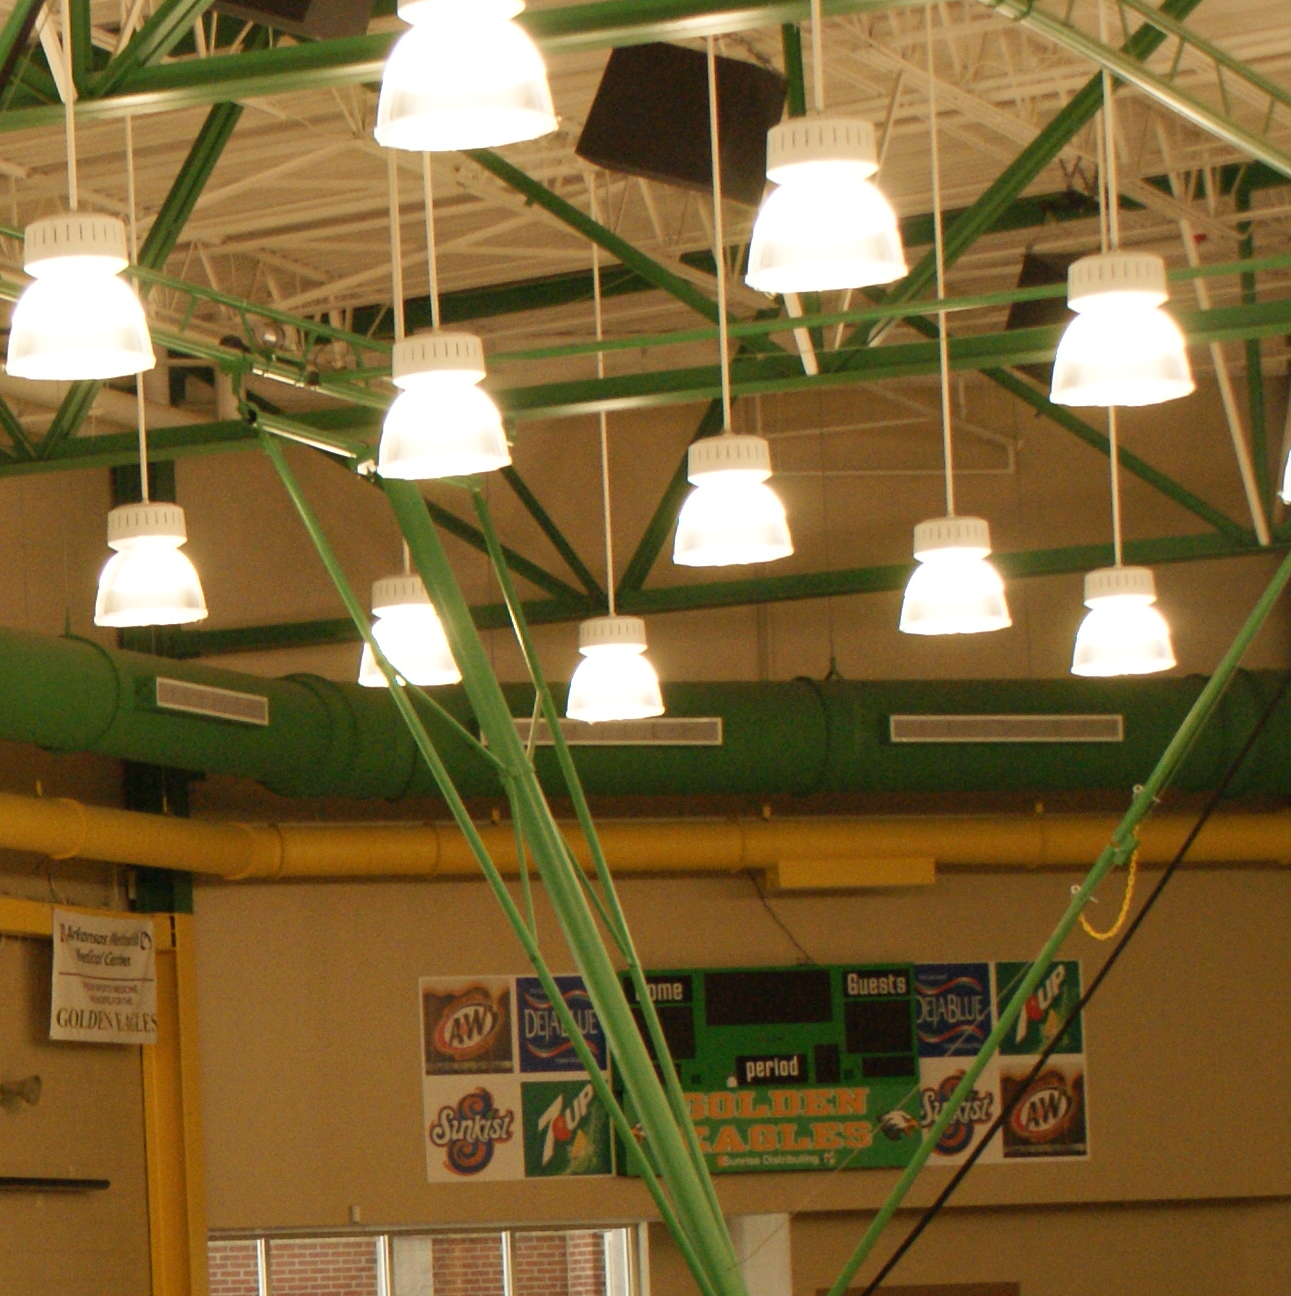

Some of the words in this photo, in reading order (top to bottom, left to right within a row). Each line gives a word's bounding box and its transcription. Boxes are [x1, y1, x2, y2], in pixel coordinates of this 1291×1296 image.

[635, 981, 683, 1002] ome
[847, 973, 907, 995] Guests
[56, 1007, 113, 1031] GOLDEN
[745, 1055, 800, 1083] period
[683, 1087, 870, 1121] GOLDEN
[431, 1108, 512, 1145] Sunkist
